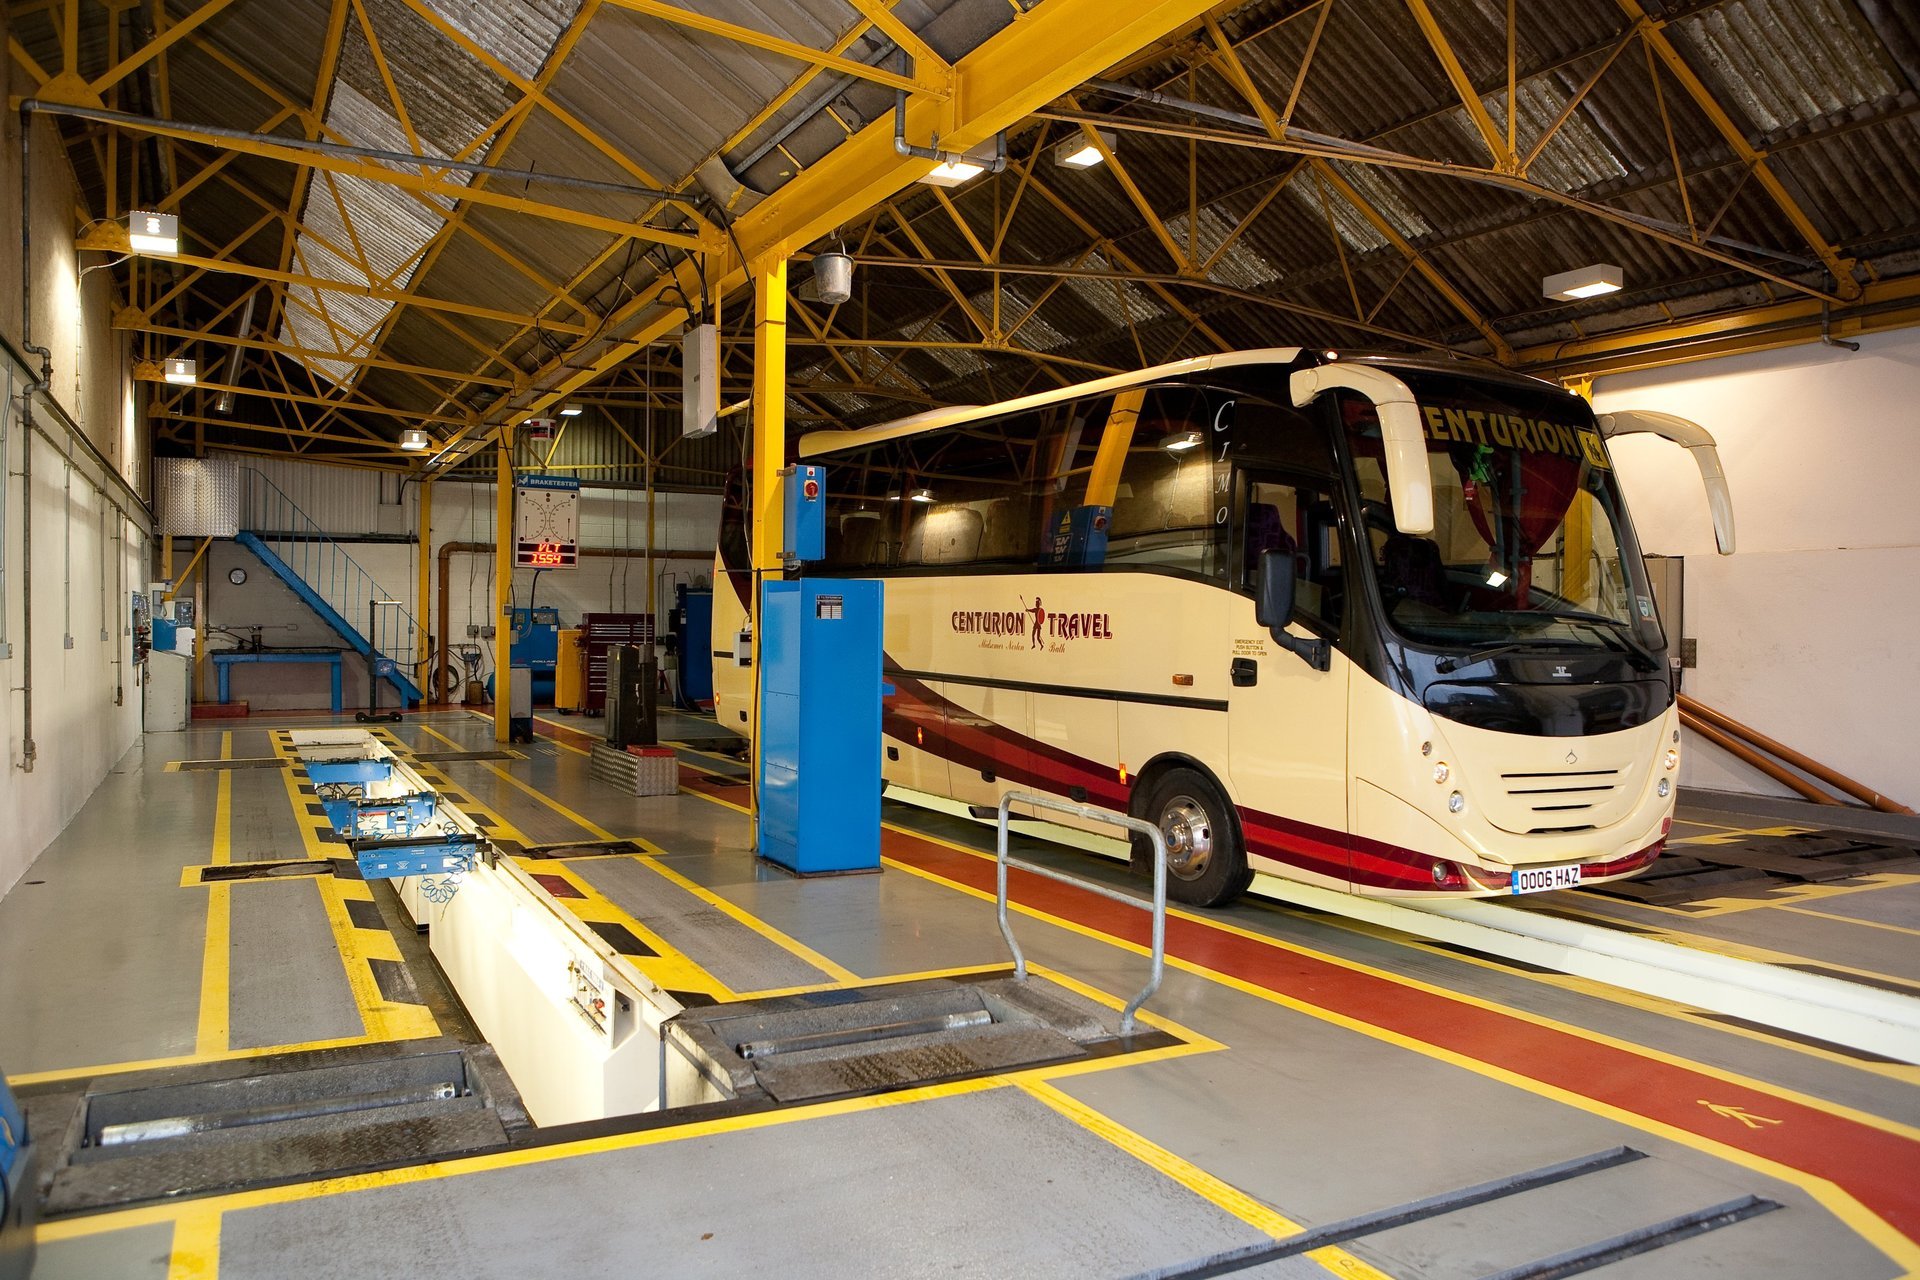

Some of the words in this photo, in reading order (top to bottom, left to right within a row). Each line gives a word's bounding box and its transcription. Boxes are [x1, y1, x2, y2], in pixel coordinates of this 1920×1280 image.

[1423, 406, 1581, 457] ENTURION
[530, 478, 577, 487] BRAKETESTER
[538, 543, 560, 552] VLT
[531, 553, 561, 564] 1554
[951, 611, 1025, 637] CENTURION
[1048, 613, 1113, 640] TRAVEL
[1556, 867, 1579, 886] HAZ
